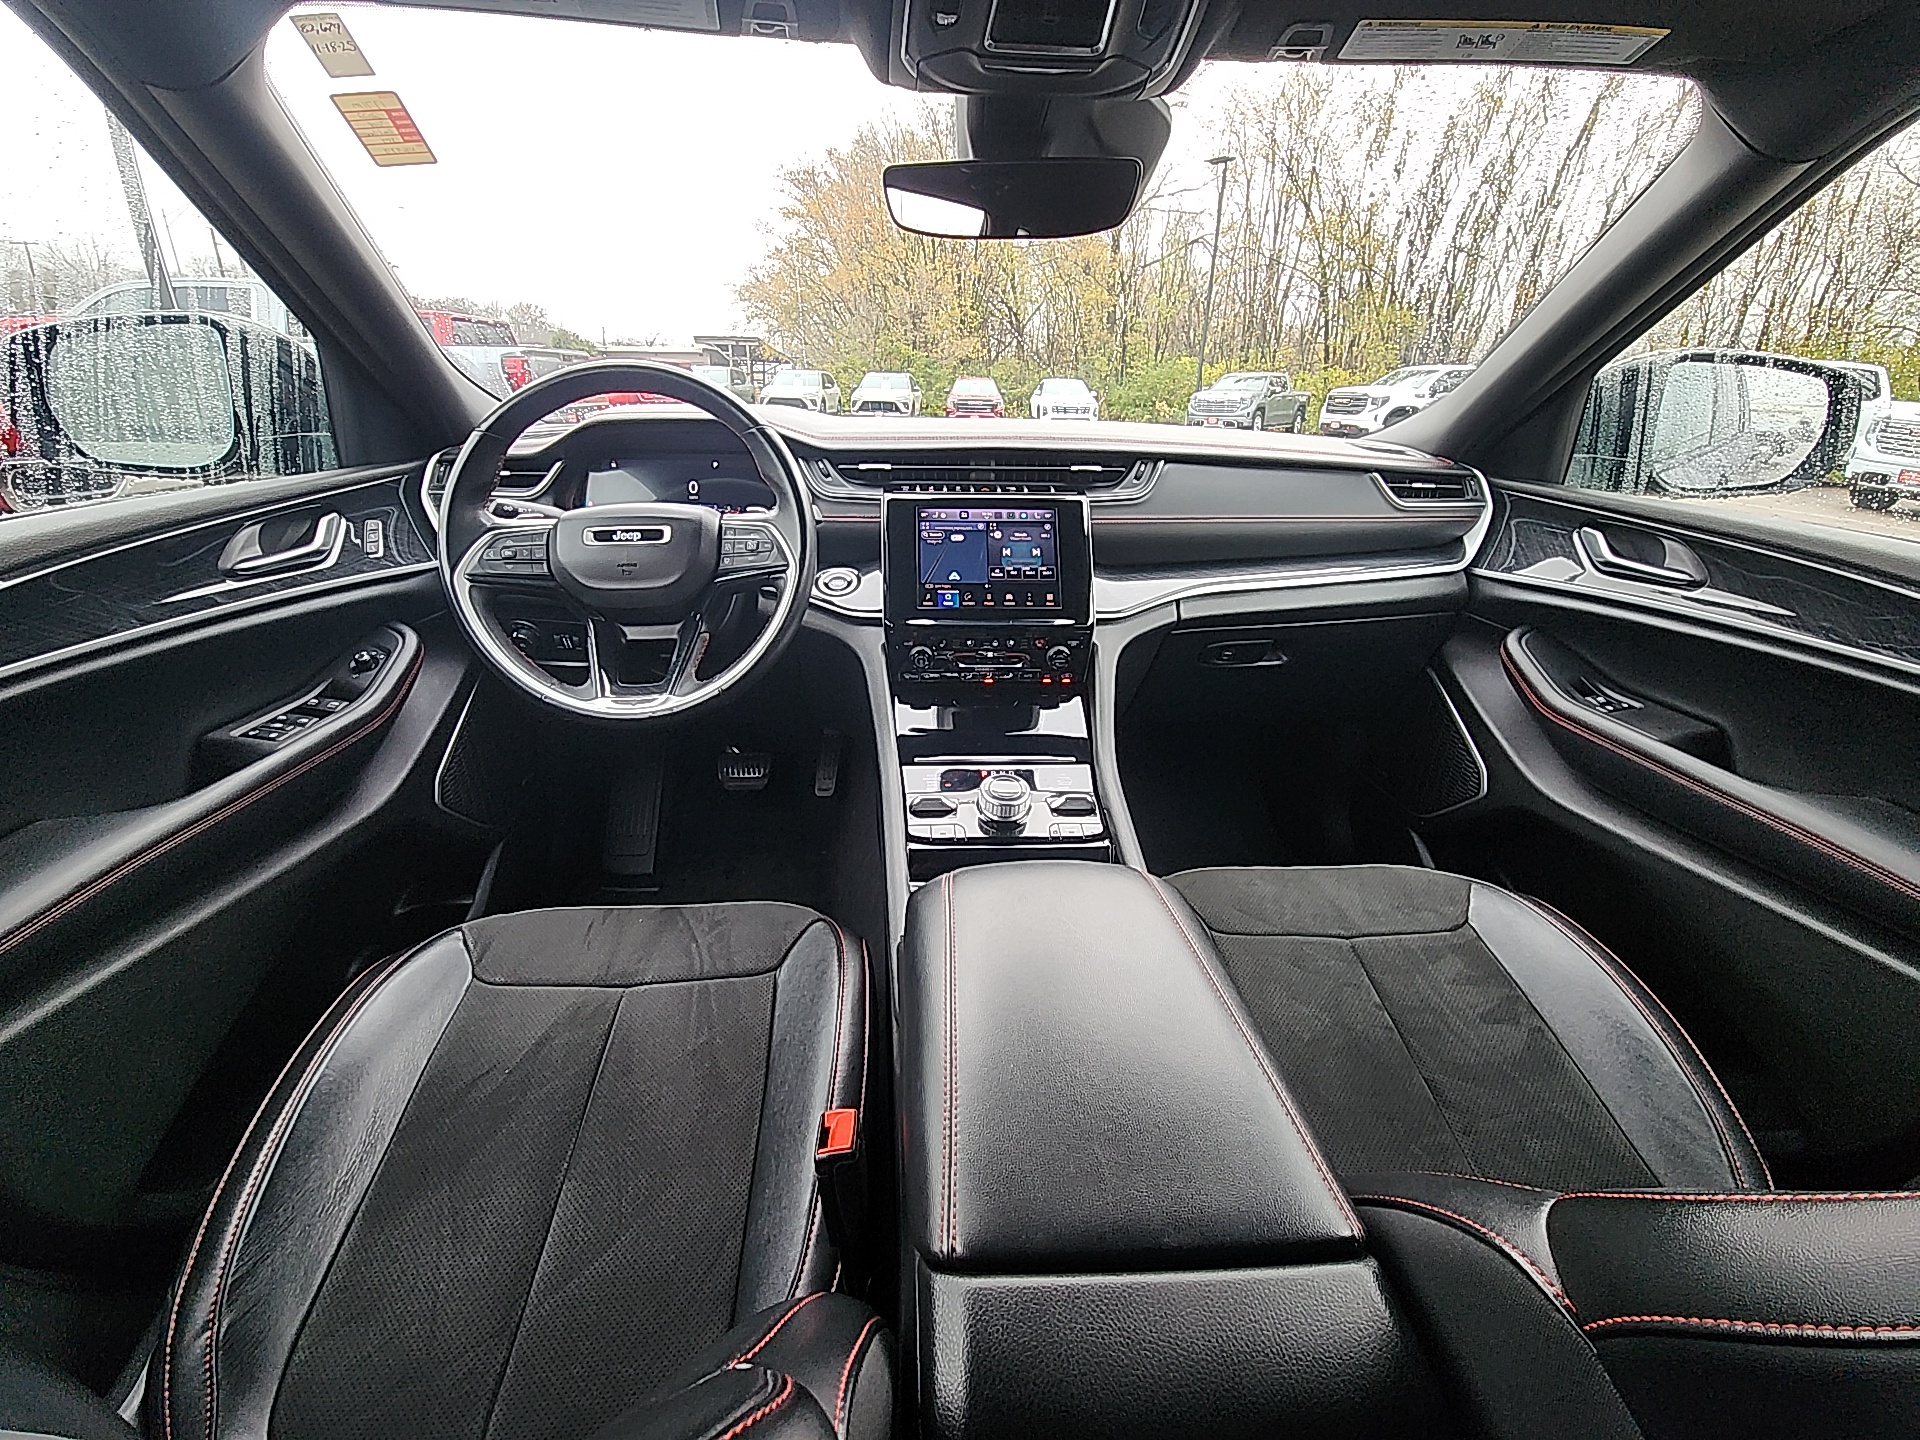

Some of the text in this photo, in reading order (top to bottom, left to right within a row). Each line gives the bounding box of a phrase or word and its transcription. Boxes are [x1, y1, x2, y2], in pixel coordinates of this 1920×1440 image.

[311, 40, 357, 53] 11-18-25
[688, 481, 699, 494] 0
[612, 528, 641, 542] Jeep
[981, 770, 988, 778] P
